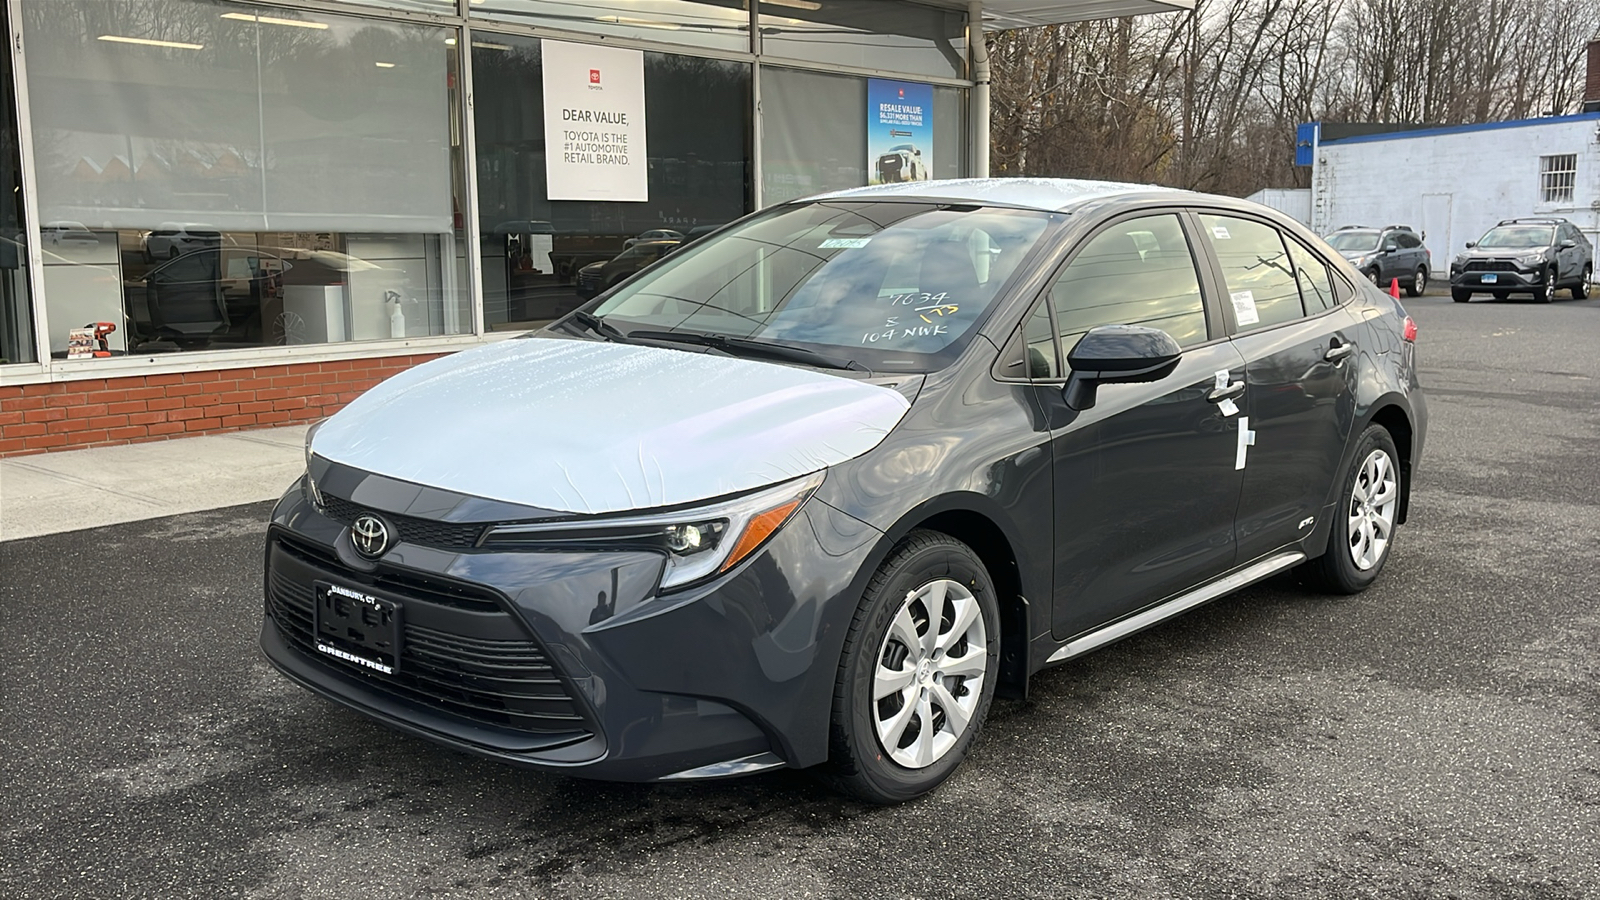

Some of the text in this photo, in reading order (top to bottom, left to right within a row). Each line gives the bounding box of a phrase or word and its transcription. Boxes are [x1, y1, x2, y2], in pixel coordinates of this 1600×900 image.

[880, 103, 922, 114] RESALE VALUE:
[563, 109, 630, 127] DEAR VALUE,
[564, 130, 628, 144] TOYOTA IS THE
[564, 142, 628, 155] #1 AUTOMOTIVE
[564, 152, 631, 166] RETAIL BRAND.
[861, 325, 948, 344] 104 NWK
[331, 585, 376, 605] DANBURY, CT
[318, 644, 392, 674] GREENTREE
